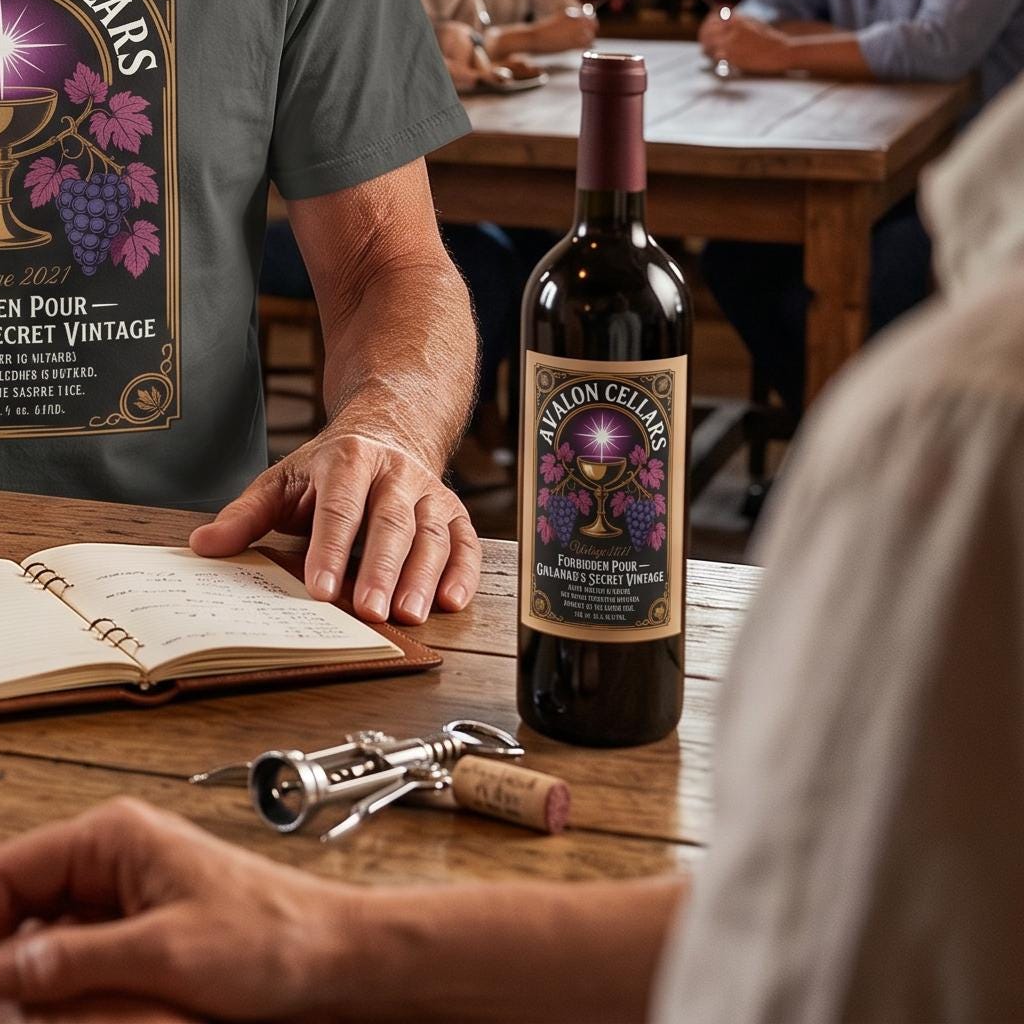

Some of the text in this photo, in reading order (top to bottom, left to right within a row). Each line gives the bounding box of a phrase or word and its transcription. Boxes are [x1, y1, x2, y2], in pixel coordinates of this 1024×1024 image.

[18, 265, 72, 286] 2021
[30, 295, 88, 318] POUR
[64, 318, 157, 347] VINTAGE
[539, 382, 667, 452] AVALON CELLARS
[611, 560, 638, 574] POUR
